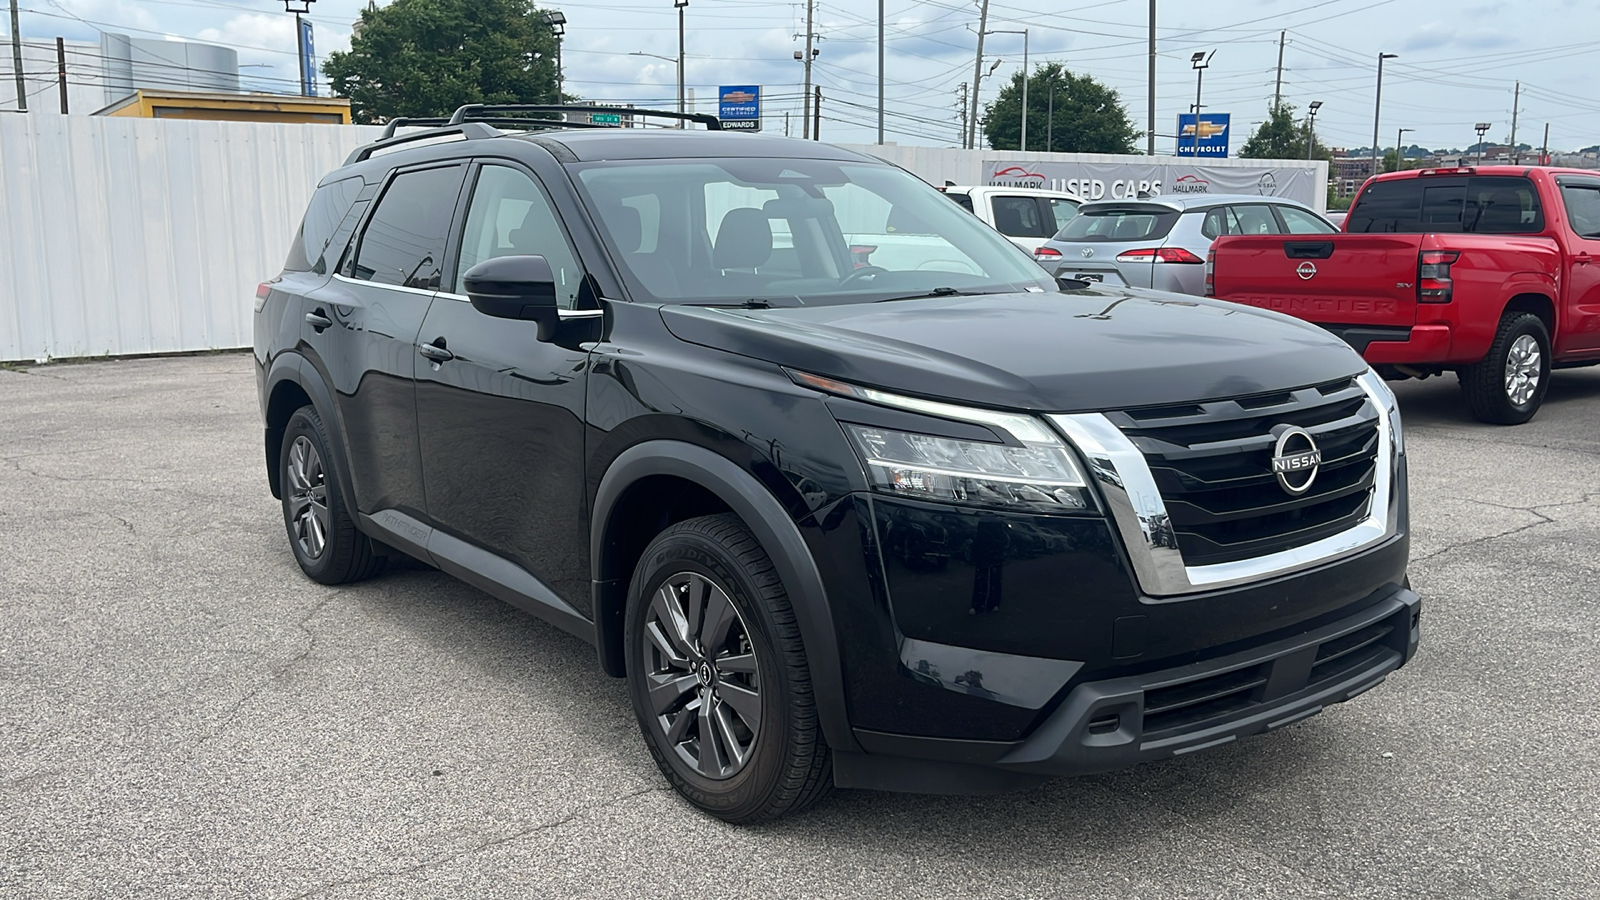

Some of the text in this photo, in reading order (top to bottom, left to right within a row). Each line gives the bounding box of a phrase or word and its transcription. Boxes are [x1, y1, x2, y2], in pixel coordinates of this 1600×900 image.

[1050, 178, 1162, 200] USED CARS
[1172, 185, 1207, 194] HALLMARK
[1232, 296, 1397, 315] FRONTIER
[1274, 453, 1321, 471] NISSAN
[382, 513, 428, 540] PATHFINDER
[656, 547, 748, 607] GOODYEAR
